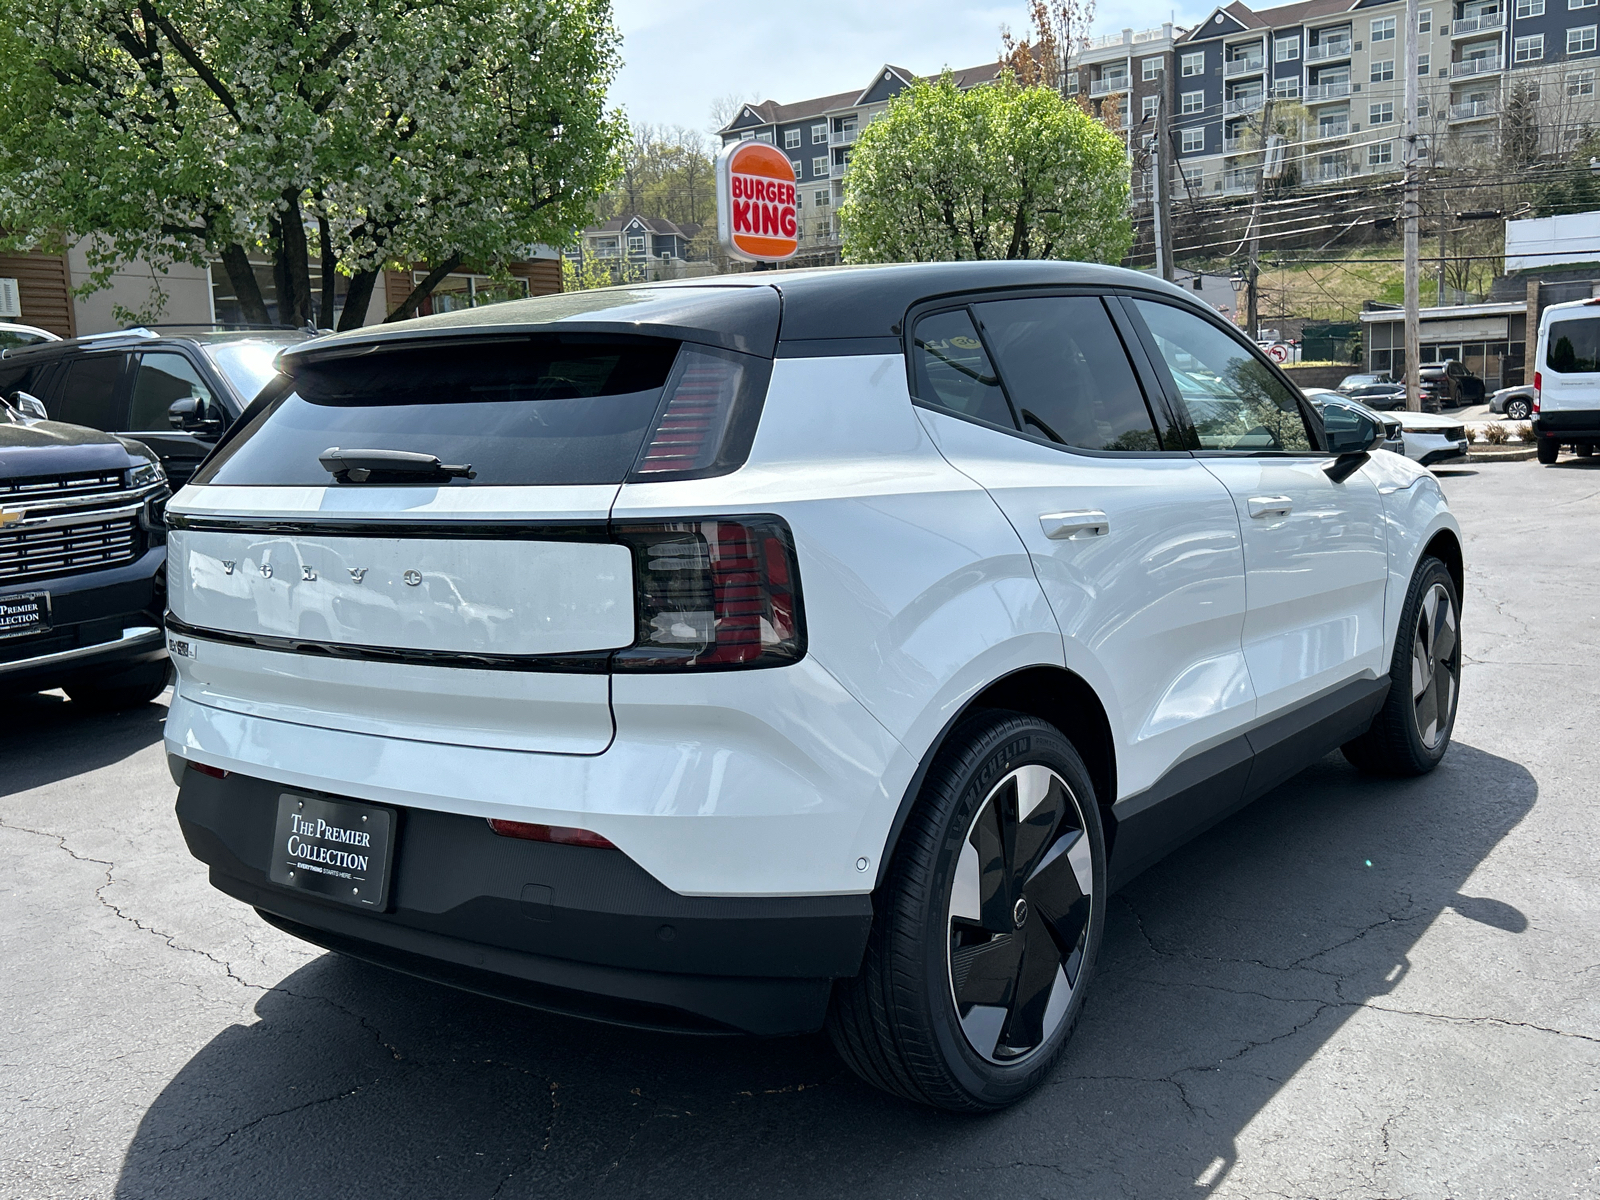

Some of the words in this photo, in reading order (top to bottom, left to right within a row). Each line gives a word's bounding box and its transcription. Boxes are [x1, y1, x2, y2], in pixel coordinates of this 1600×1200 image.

[731, 176, 796, 206] BURGER
[732, 199, 797, 238] KING
[221, 560, 423, 587] VOLVO
[0, 603, 38, 616] PREMIER
[0, 613, 39, 625] LECTION
[965, 737, 1028, 811] MICHELIN
[290, 813, 315, 837] THE
[315, 818, 371, 848] PREMIER
[287, 835, 369, 872] COLLECTION
[297, 862, 323, 874] EVERYTHING
[322, 868, 339, 877] STARTS
